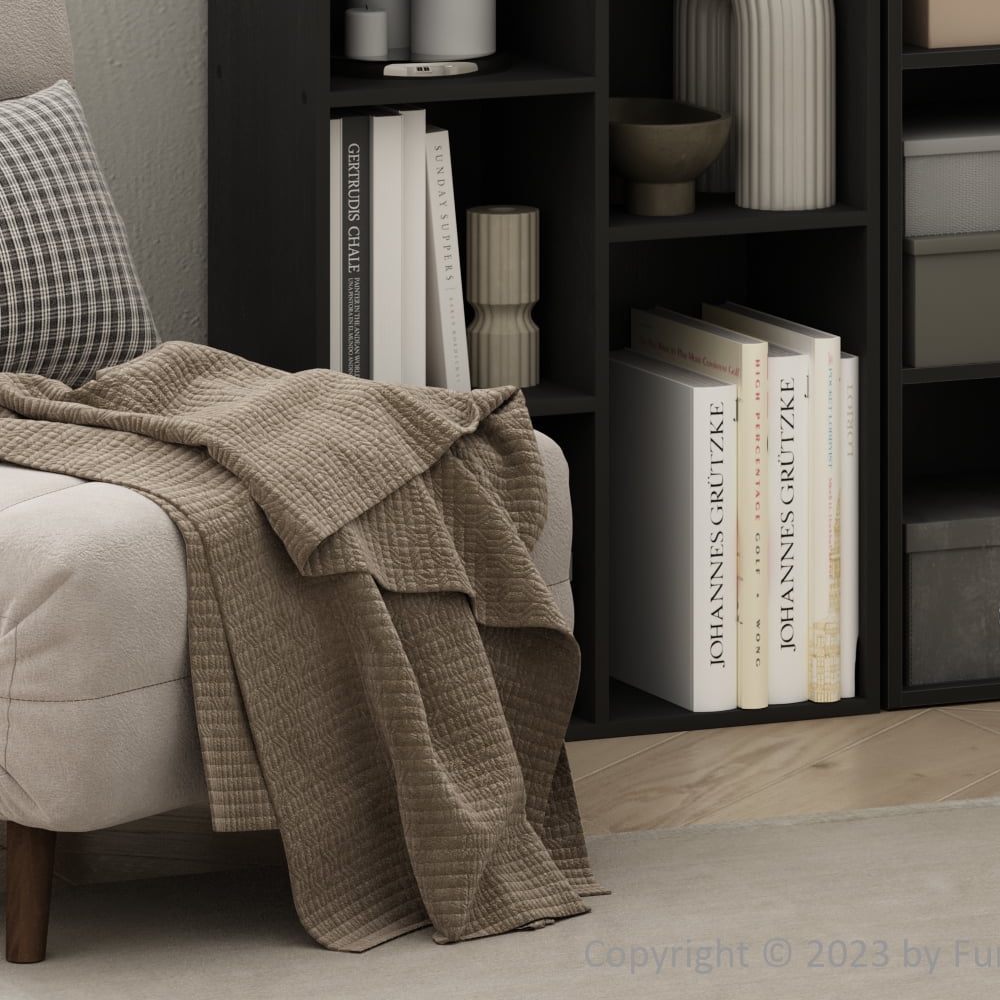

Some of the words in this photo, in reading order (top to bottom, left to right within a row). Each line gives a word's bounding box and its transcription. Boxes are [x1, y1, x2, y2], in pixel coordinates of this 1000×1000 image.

[347, 142, 361, 222] GERTRUDIS
[433, 143, 449, 207] SUNDAY
[347, 226, 361, 274] CHALE
[439, 213, 456, 282] SUPPERS
[707, 402, 725, 526] GRÜTZKE
[778, 378, 795, 505] GRÜTZKE
[709, 531, 726, 669] JOHANNES
[780, 510, 796, 653] JOHANNES
